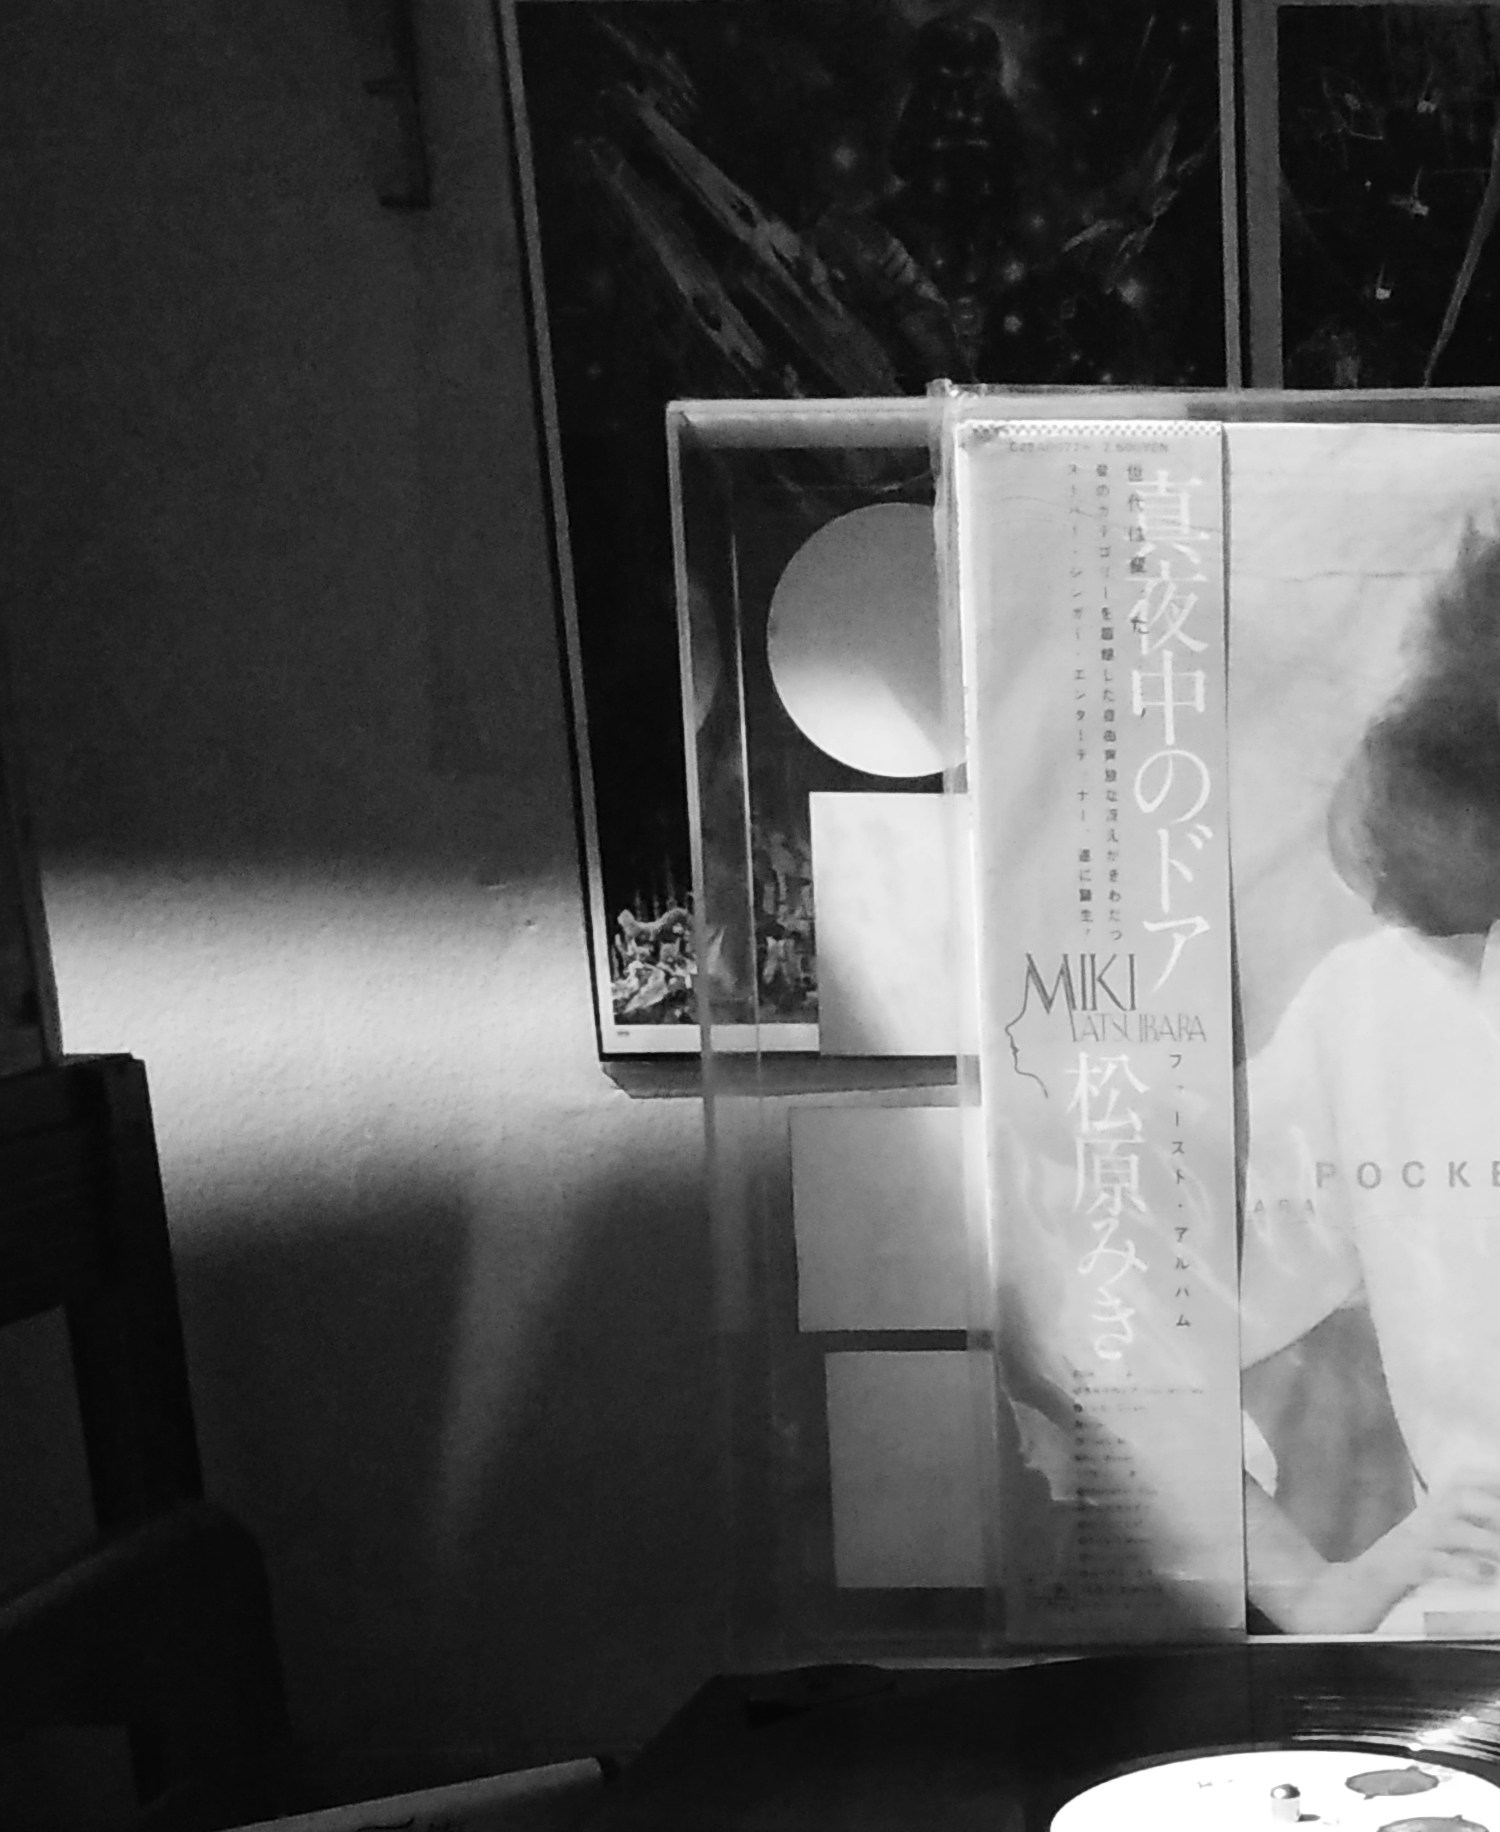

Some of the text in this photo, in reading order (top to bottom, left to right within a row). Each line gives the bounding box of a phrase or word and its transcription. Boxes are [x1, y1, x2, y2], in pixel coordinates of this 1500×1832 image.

[1125, 470, 1213, 995] 真夜中のドア
[1025, 953, 1136, 1013] MIKI
[1065, 1051, 1150, 1361] 松原みき
